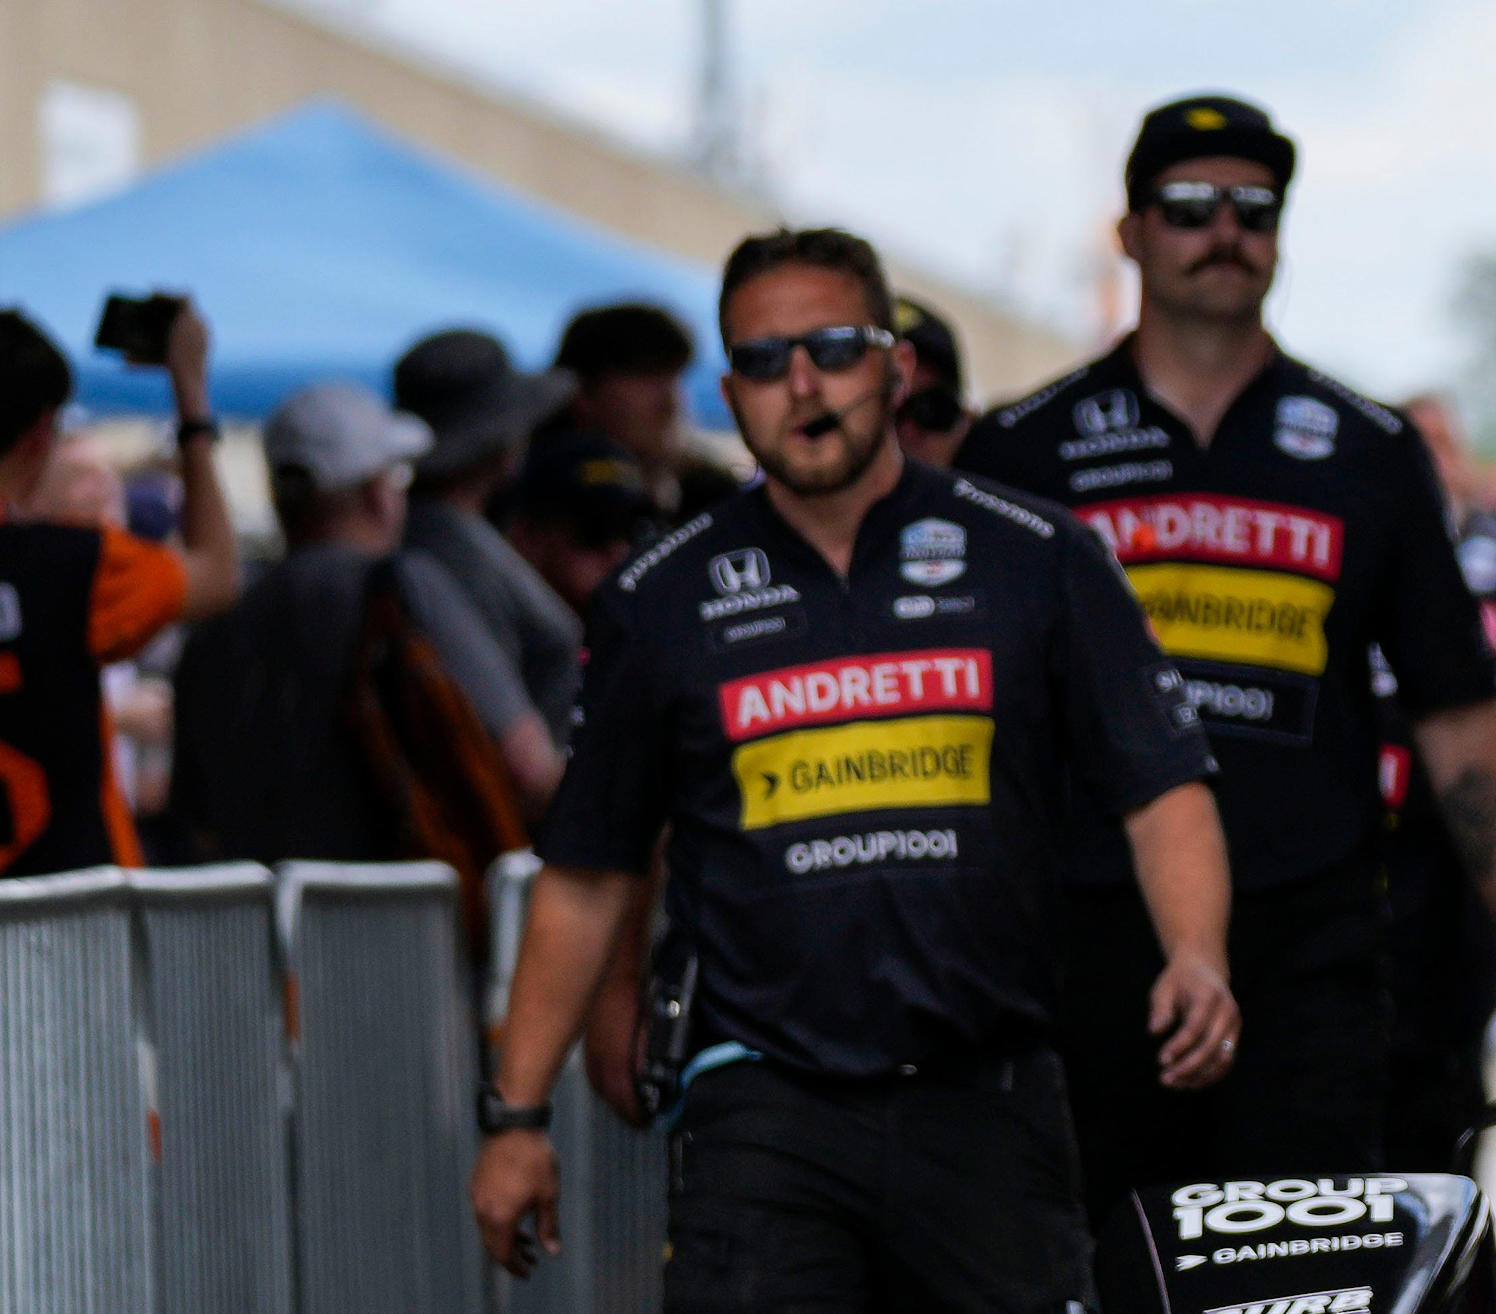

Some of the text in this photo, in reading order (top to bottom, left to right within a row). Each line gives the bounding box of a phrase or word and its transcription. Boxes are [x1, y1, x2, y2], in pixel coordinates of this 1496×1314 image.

[737, 657, 980, 729] ANDRETTI
[790, 743, 975, 795] GAINBRIDGE
[785, 829, 958, 874] GROUP1001
[1172, 1177, 1408, 1208] GROUP
[1173, 1194, 1396, 1240] 1001
[1212, 1232, 1404, 1265] GAINBRIDGE
